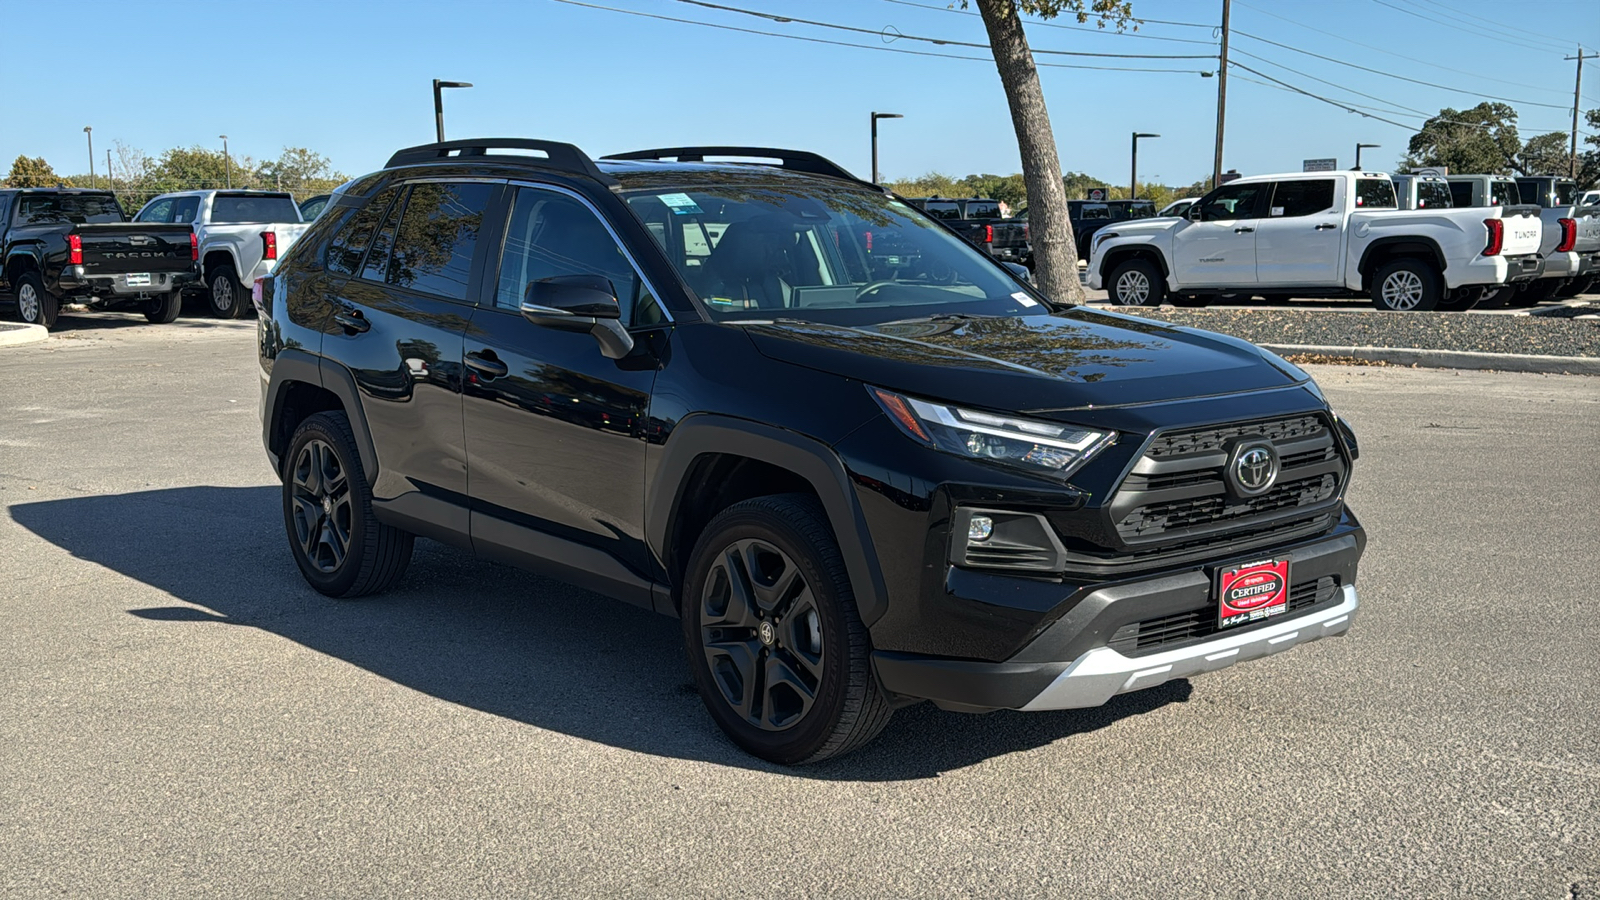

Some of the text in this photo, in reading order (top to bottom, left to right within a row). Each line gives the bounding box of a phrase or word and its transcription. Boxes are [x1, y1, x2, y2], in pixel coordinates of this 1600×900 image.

[1514, 230, 1537, 239] TUNDRA
[101, 251, 177, 259] TACOMA
[1231, 582, 1276, 599] CERTIFIED
